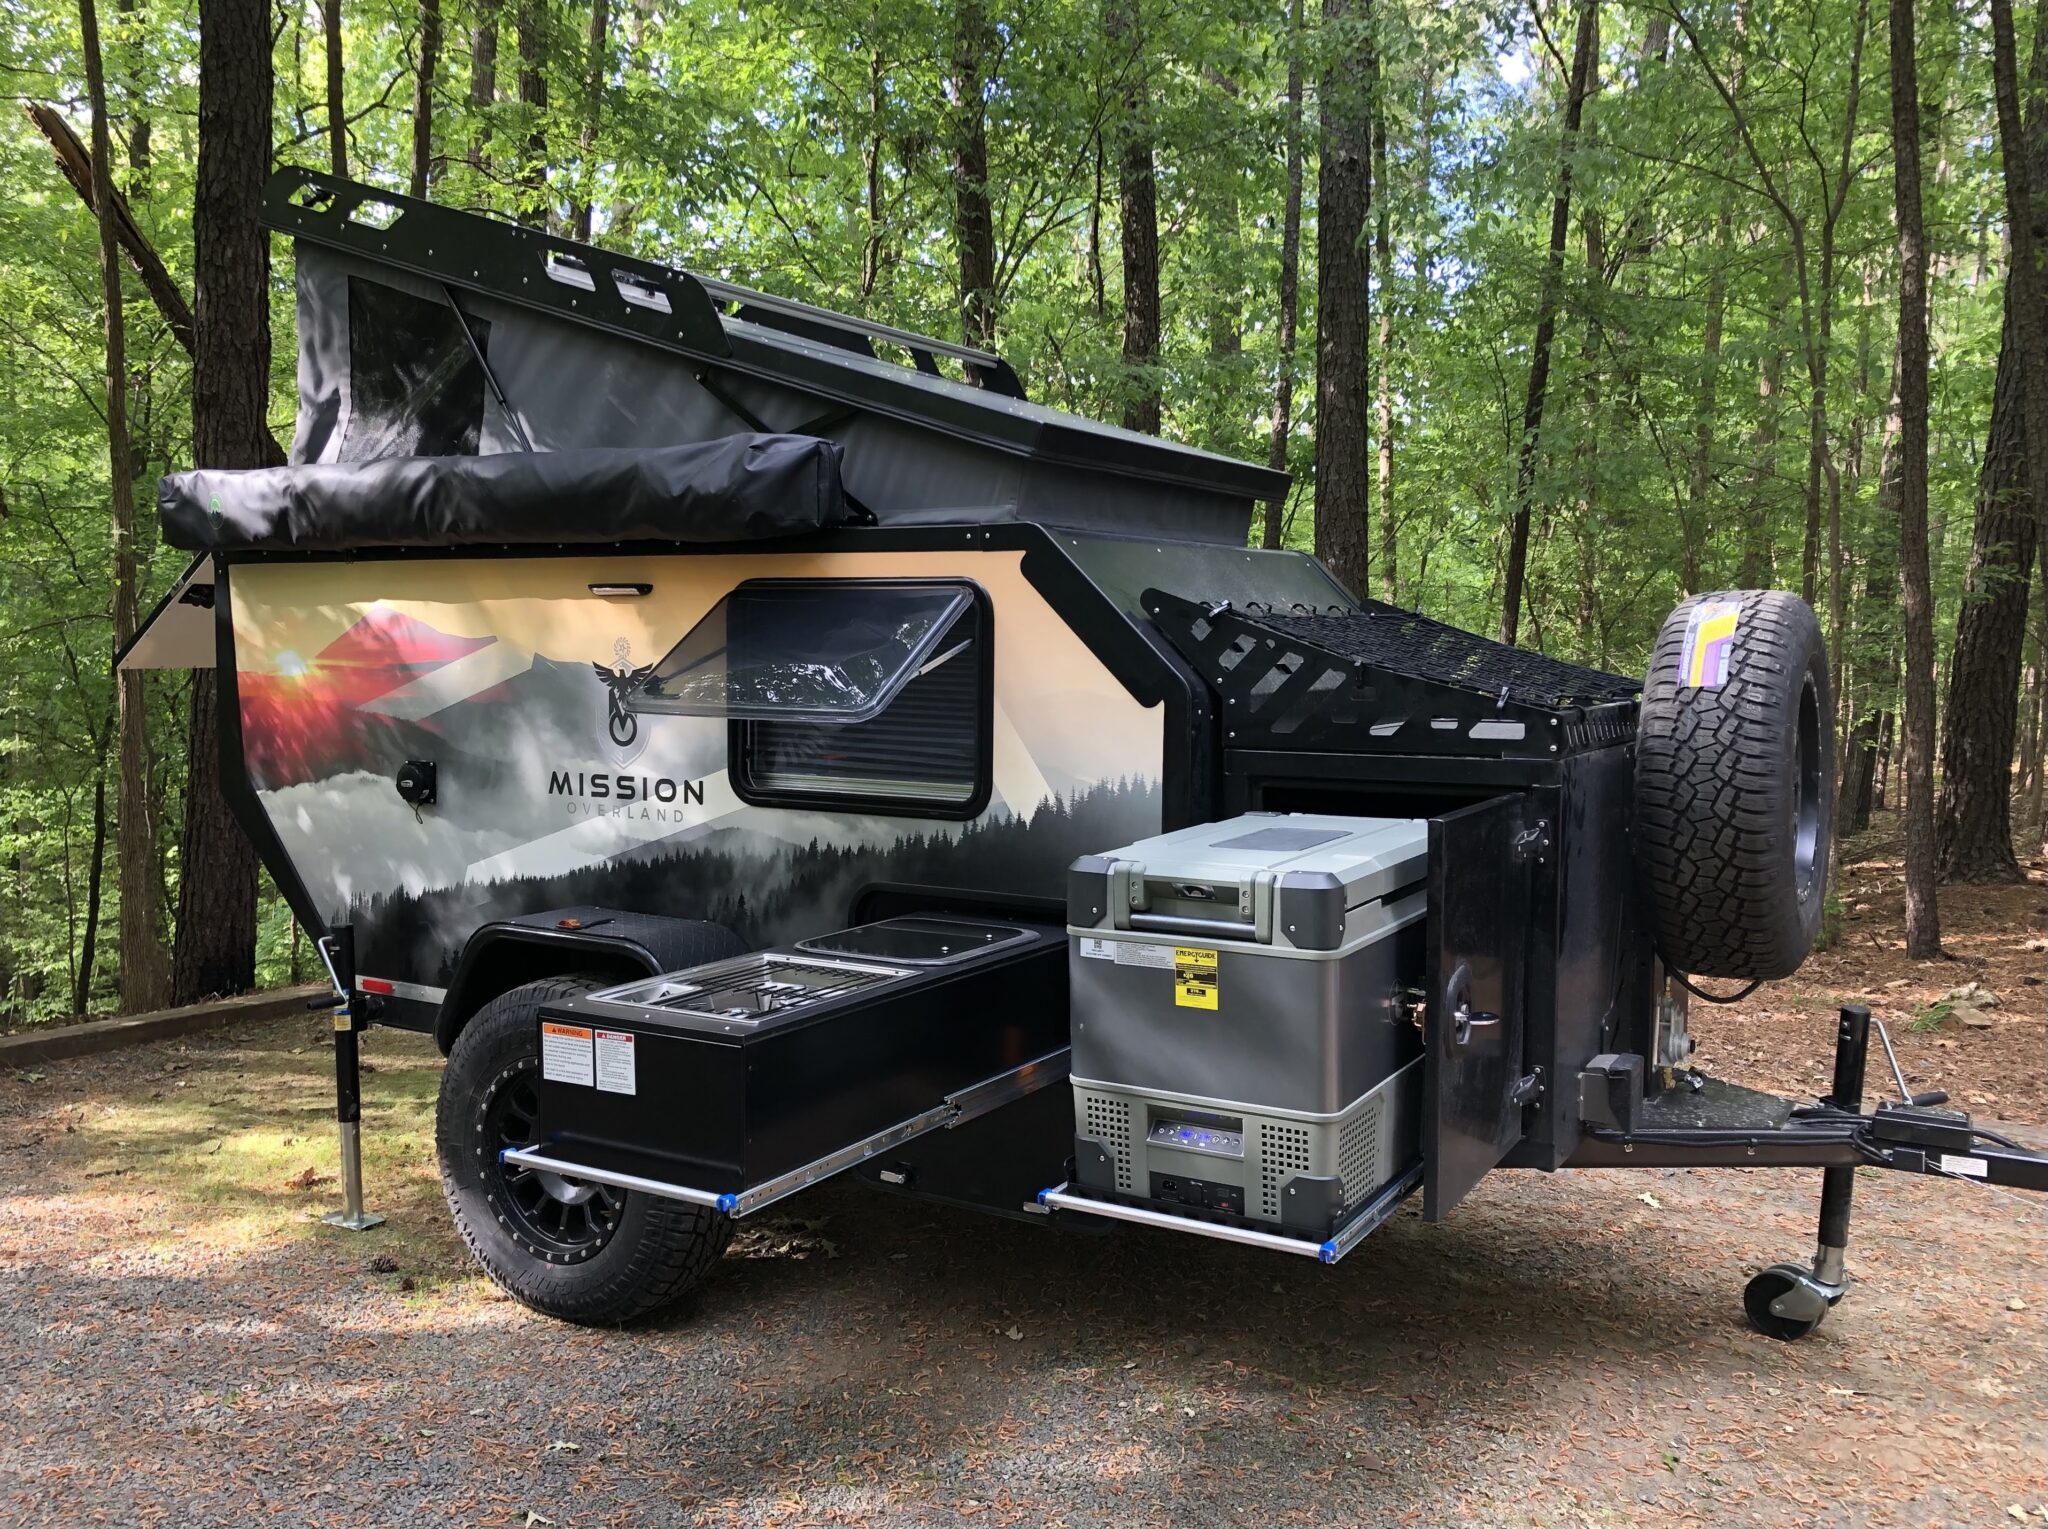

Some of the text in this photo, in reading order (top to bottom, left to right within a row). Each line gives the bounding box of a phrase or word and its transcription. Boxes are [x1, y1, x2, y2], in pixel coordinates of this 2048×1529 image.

[548, 770, 704, 806] MISSION
[567, 802, 684, 823] OVERLAND
[557, 1027, 583, 1037] WARNING
[606, 1033, 627, 1041] DANGER
